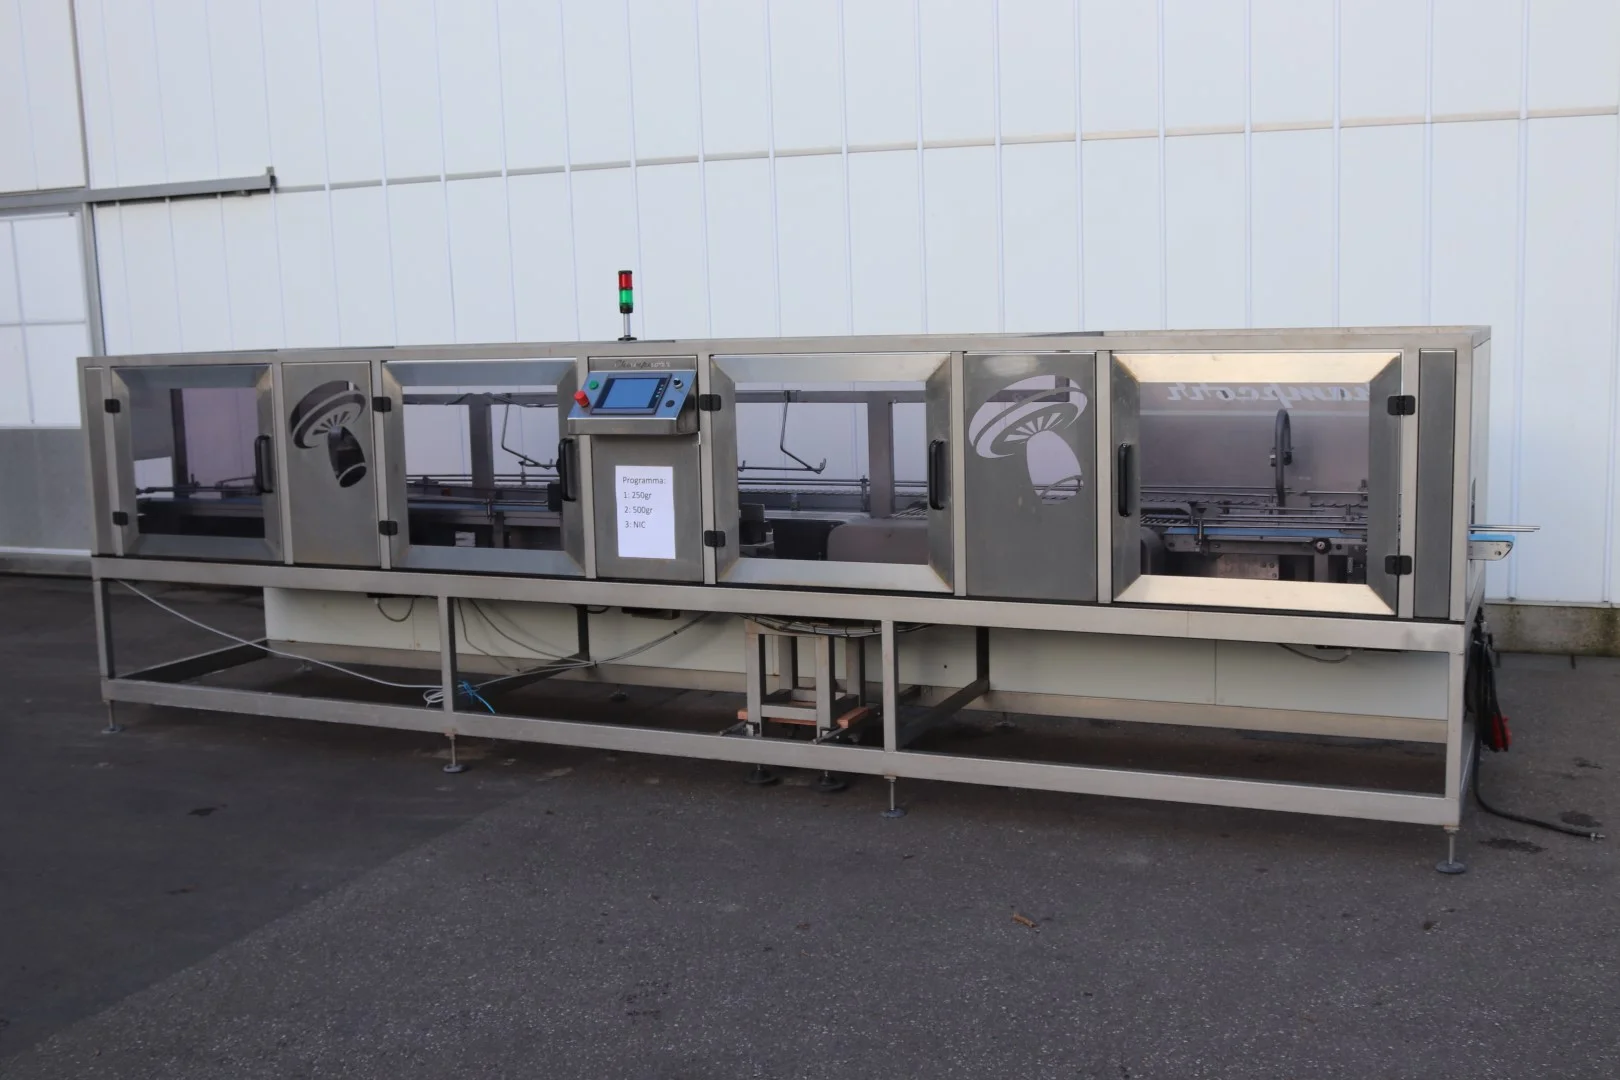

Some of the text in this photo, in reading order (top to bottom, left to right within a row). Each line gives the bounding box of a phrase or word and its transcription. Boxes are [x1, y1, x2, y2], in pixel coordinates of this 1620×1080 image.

[622, 476, 667, 486] Programma:
[623, 491, 653, 501] 1: 250gr
[624, 506, 653, 516] 2: 500gr
[624, 520, 647, 529] 3: NIC
